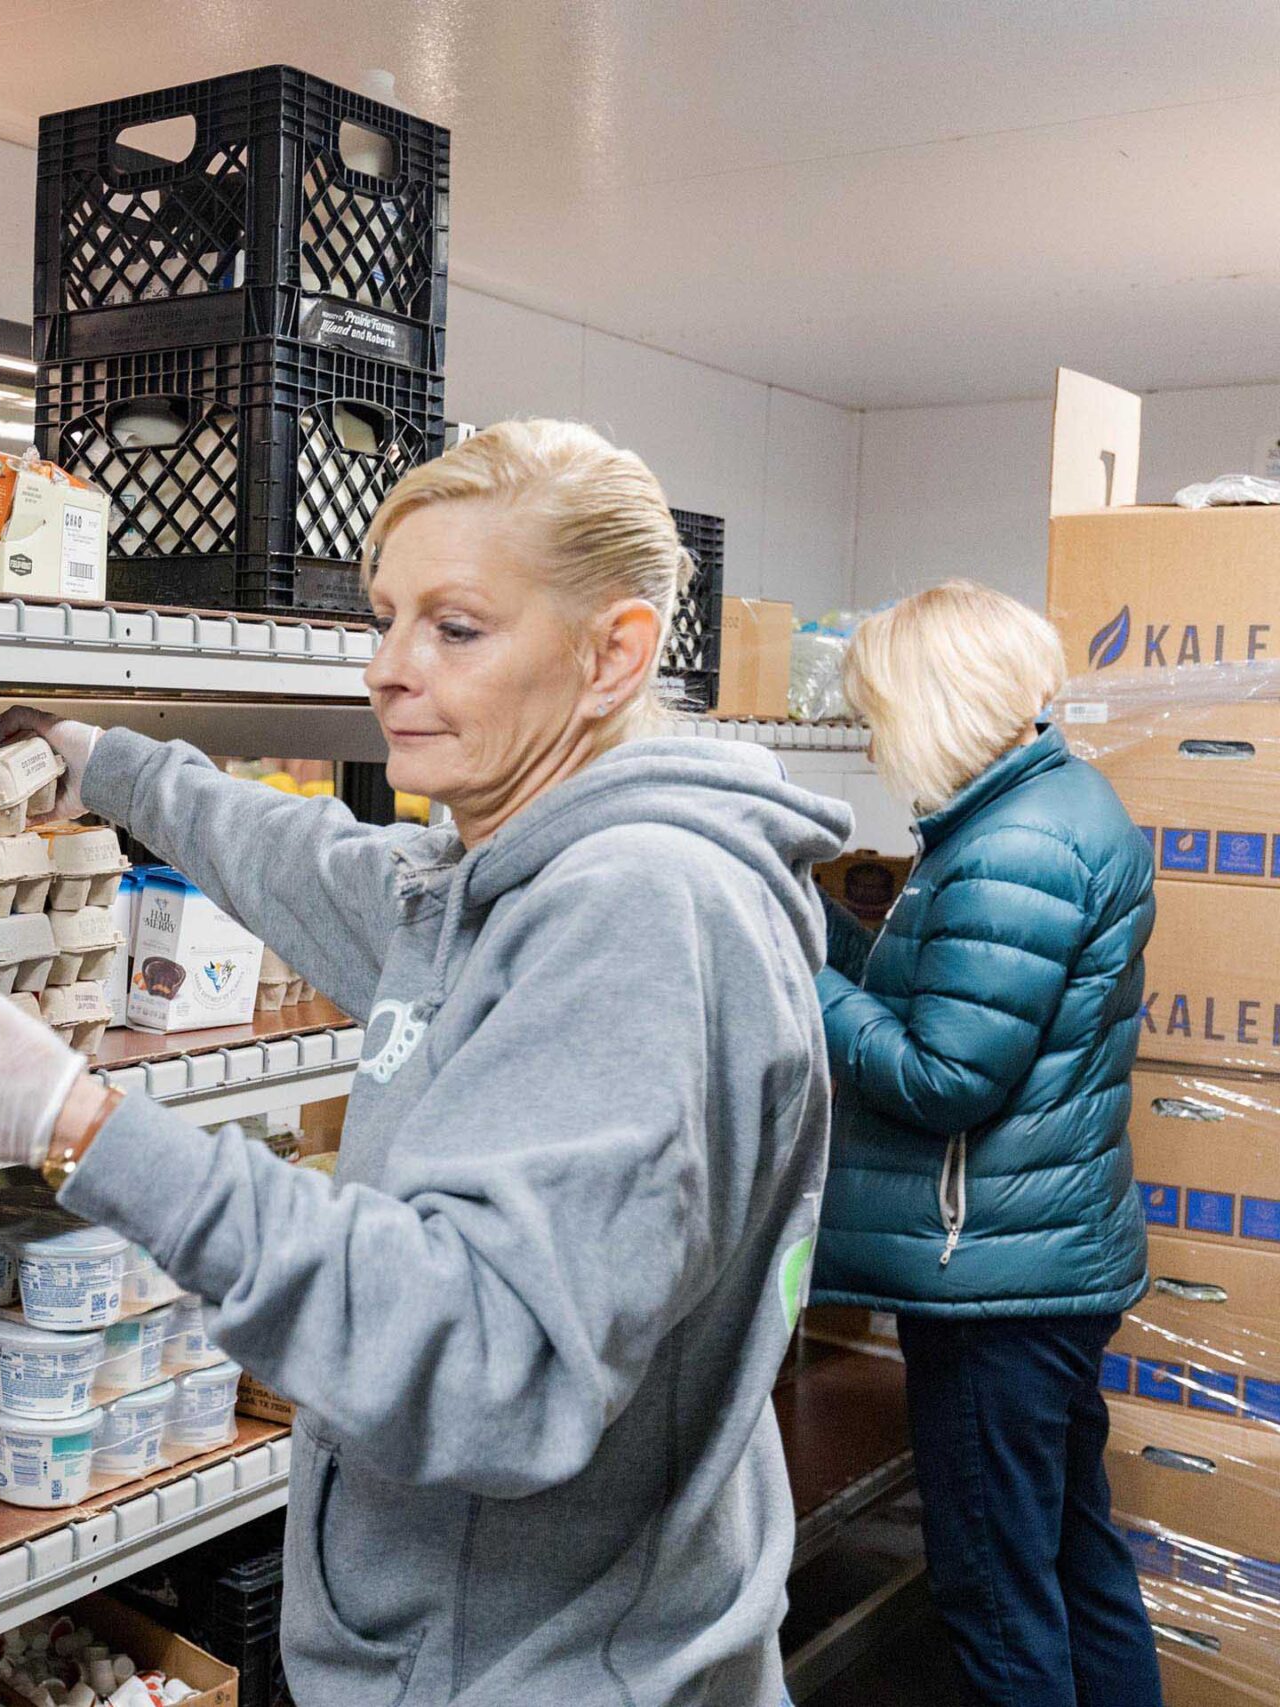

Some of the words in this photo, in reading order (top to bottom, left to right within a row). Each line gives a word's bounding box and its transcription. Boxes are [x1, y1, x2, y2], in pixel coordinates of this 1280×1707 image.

[351, 327, 366, 341] and
[366, 331, 396, 349] Roberts
[150, 909, 171, 923] HAIL
[144, 918, 177, 934] MERRY
